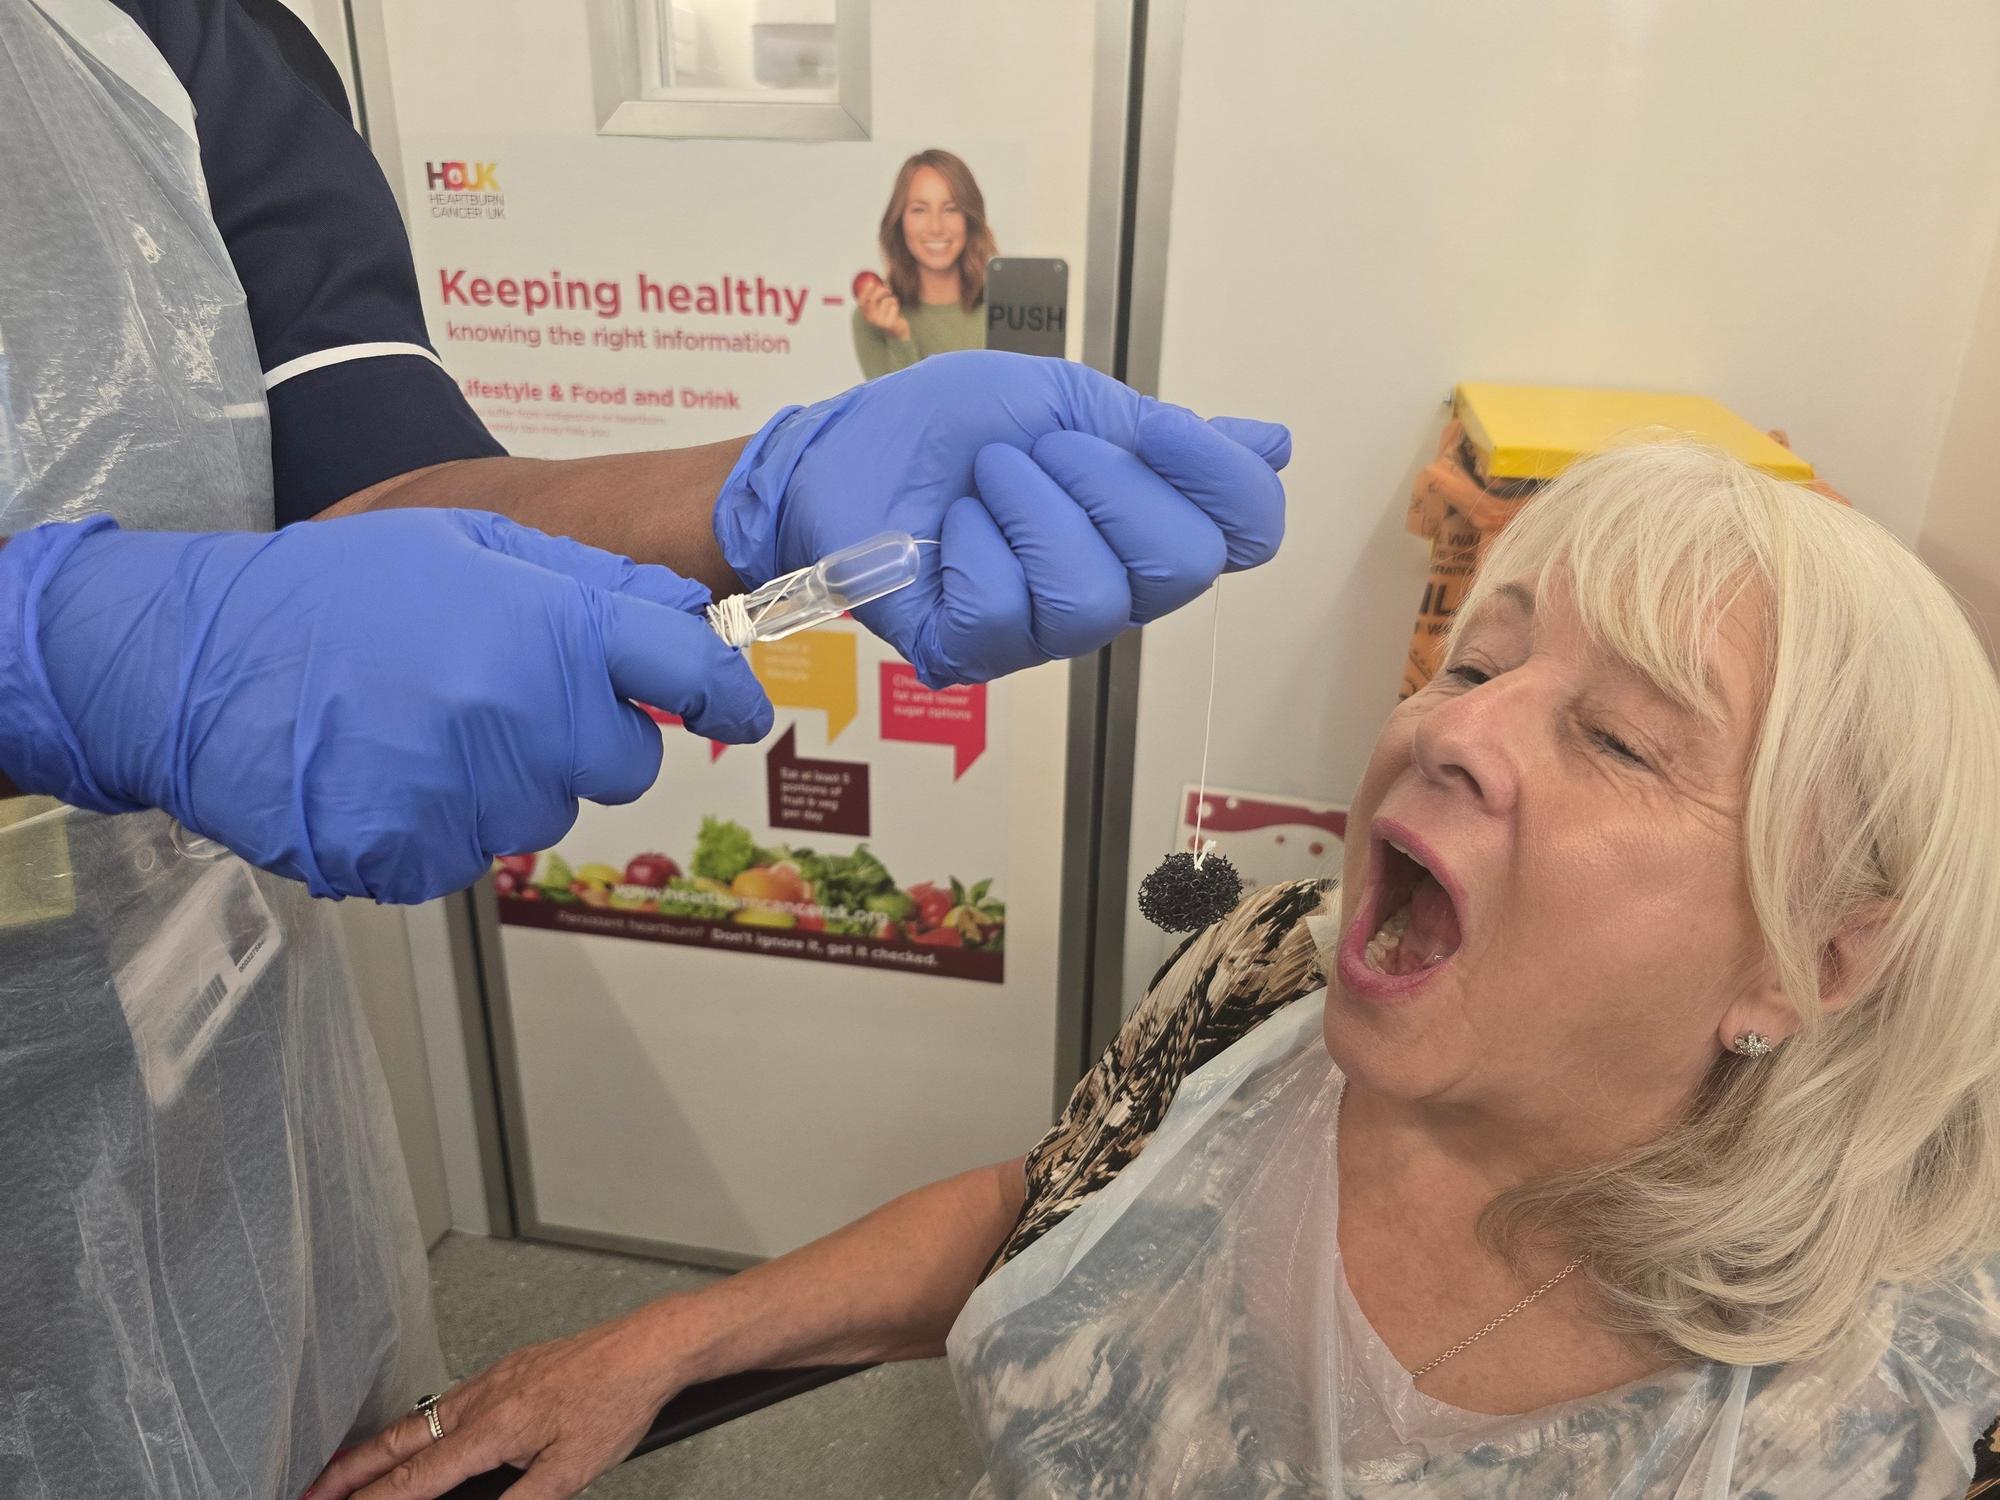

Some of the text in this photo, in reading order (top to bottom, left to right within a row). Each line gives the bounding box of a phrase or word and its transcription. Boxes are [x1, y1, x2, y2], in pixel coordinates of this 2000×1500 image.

[430, 193, 505, 206] HEARTBURN
[432, 206, 506, 220] CANCER UK
[440, 268, 622, 319] Keeping
[638, 273, 809, 325] healthy
[988, 305, 1064, 332] PUSH
[448, 321, 791, 354] knowing the right information
[550, 384, 563, 402] &
[570, 384, 626, 405] Food
[633, 389, 674, 407] and
[680, 387, 740, 410] Drink
[911, 693, 934, 704] and
[937, 695, 969, 706] lower
[893, 705, 972, 721] sugar options
[781, 767, 850, 785] Eat at least 5
[781, 782, 842, 797] portions of
[781, 793, 805, 806] fruit
[818, 800, 838, 812] veg
[781, 809, 824, 823] per day
[557, 910, 625, 928] Persistent
[711, 927, 753, 943] Don't
[757, 932, 804, 949] ignore
[827, 942, 853, 957] get
[856, 943, 868, 957] it
[871, 944, 938, 966] checked.
